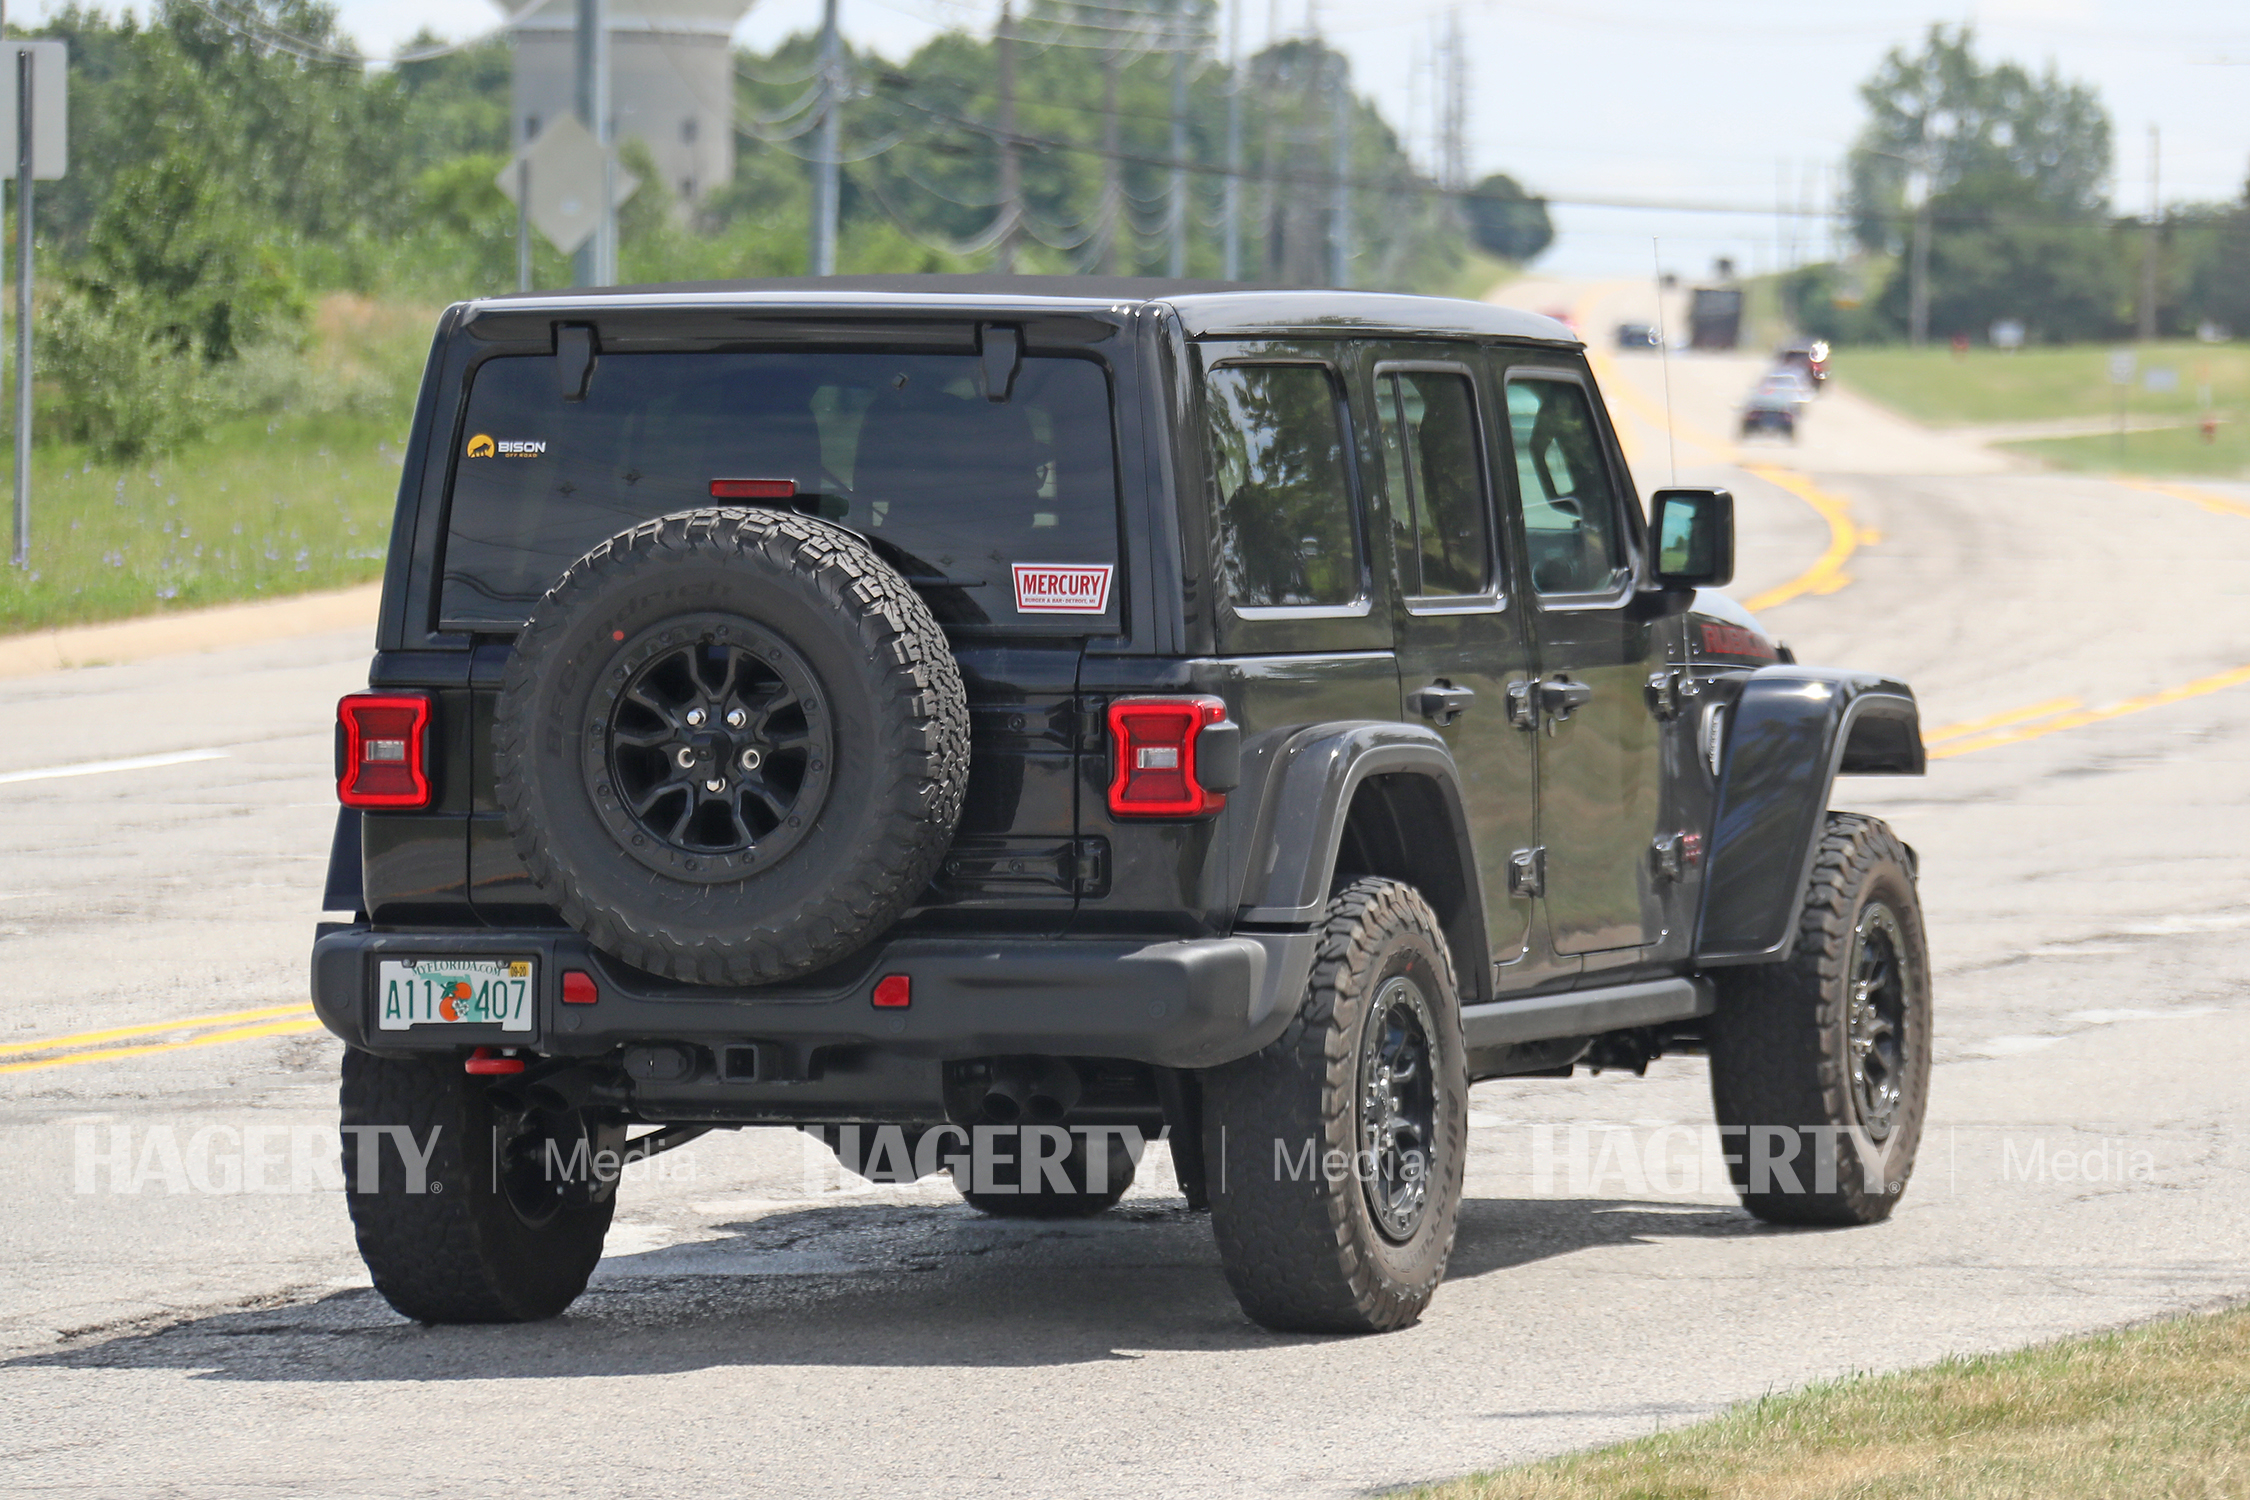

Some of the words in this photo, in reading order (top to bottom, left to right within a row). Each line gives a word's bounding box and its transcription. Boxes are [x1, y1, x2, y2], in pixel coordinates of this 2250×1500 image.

[497, 441, 547, 453] BISON
[1023, 574, 1101, 596] MERCURY
[1700, 623, 1778, 661] RUBIC
[386, 979, 432, 1020] A11
[474, 979, 526, 1020] 407
